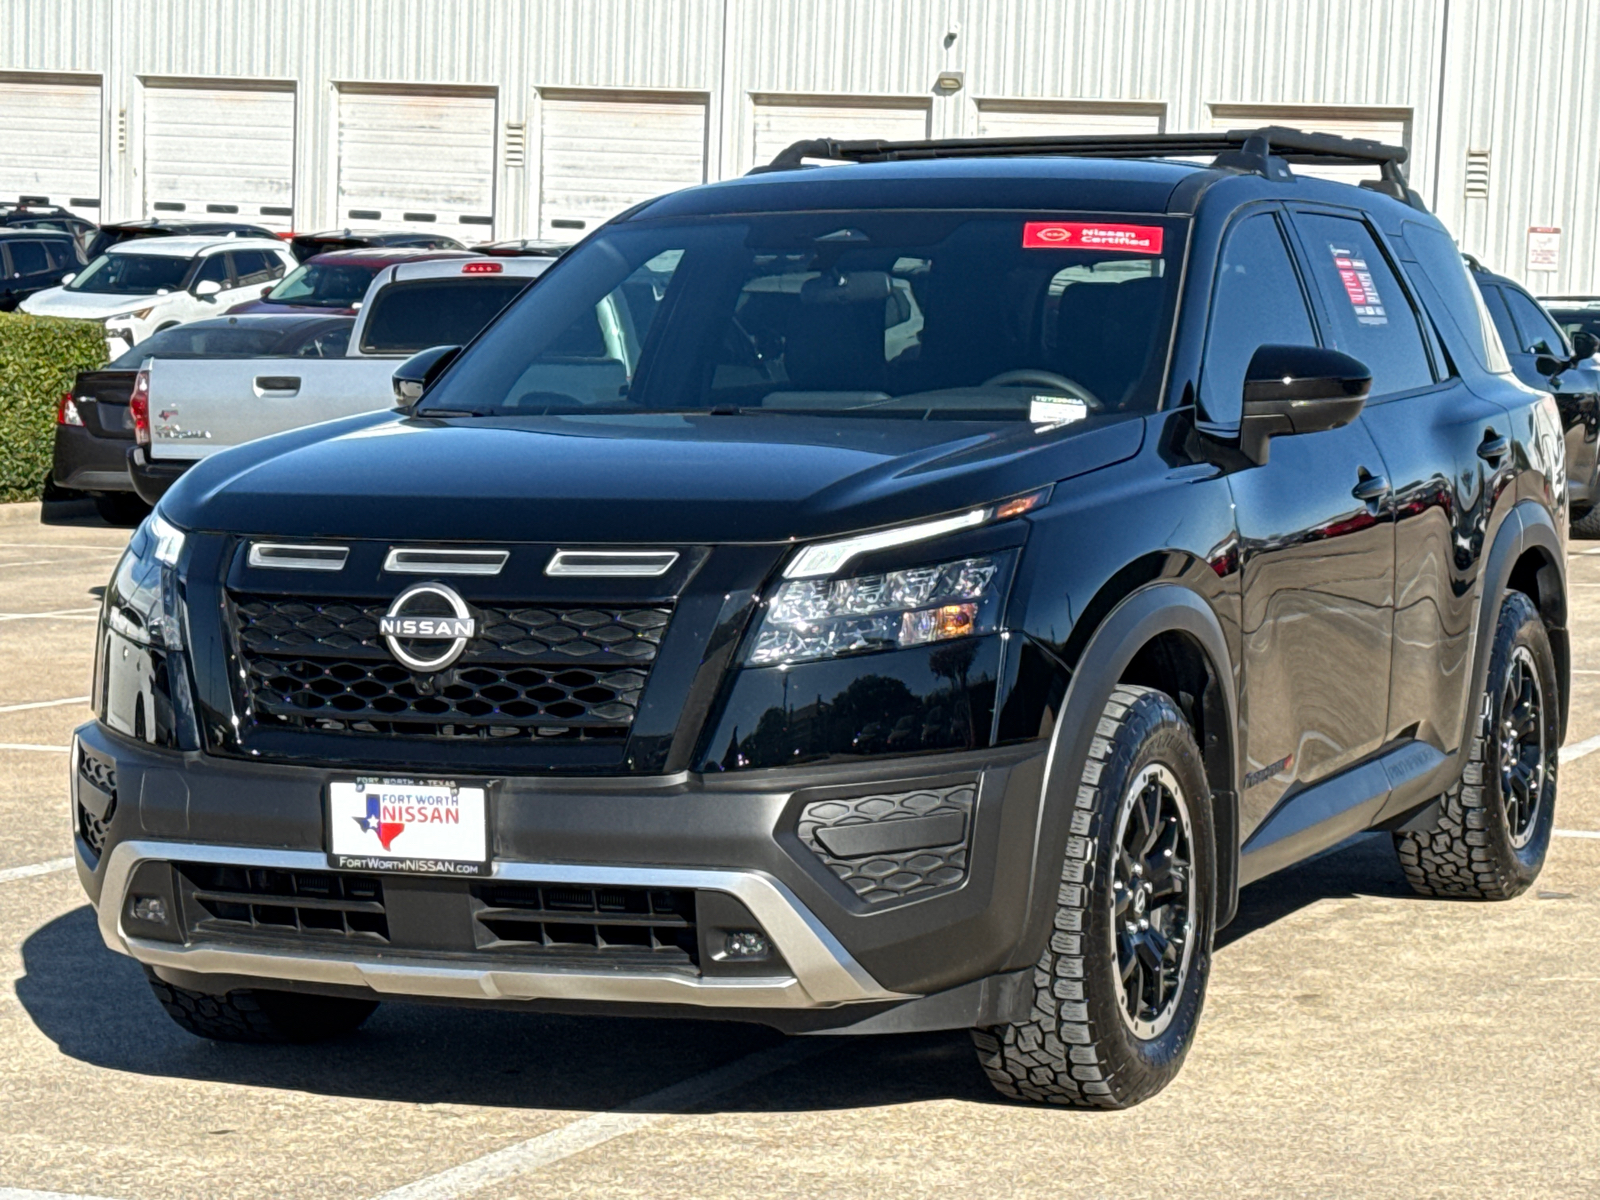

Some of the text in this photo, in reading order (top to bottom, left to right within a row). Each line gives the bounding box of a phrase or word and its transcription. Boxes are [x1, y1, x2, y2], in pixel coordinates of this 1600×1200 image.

[1081, 228, 1136, 238] Nissan
[1080, 236, 1150, 247] Certified
[381, 619, 471, 636] NISSAN
[356, 776, 457, 788] FORT WORTH TEXAS
[382, 794, 459, 806] FORT WORTH
[382, 805, 460, 825] NISSAN
